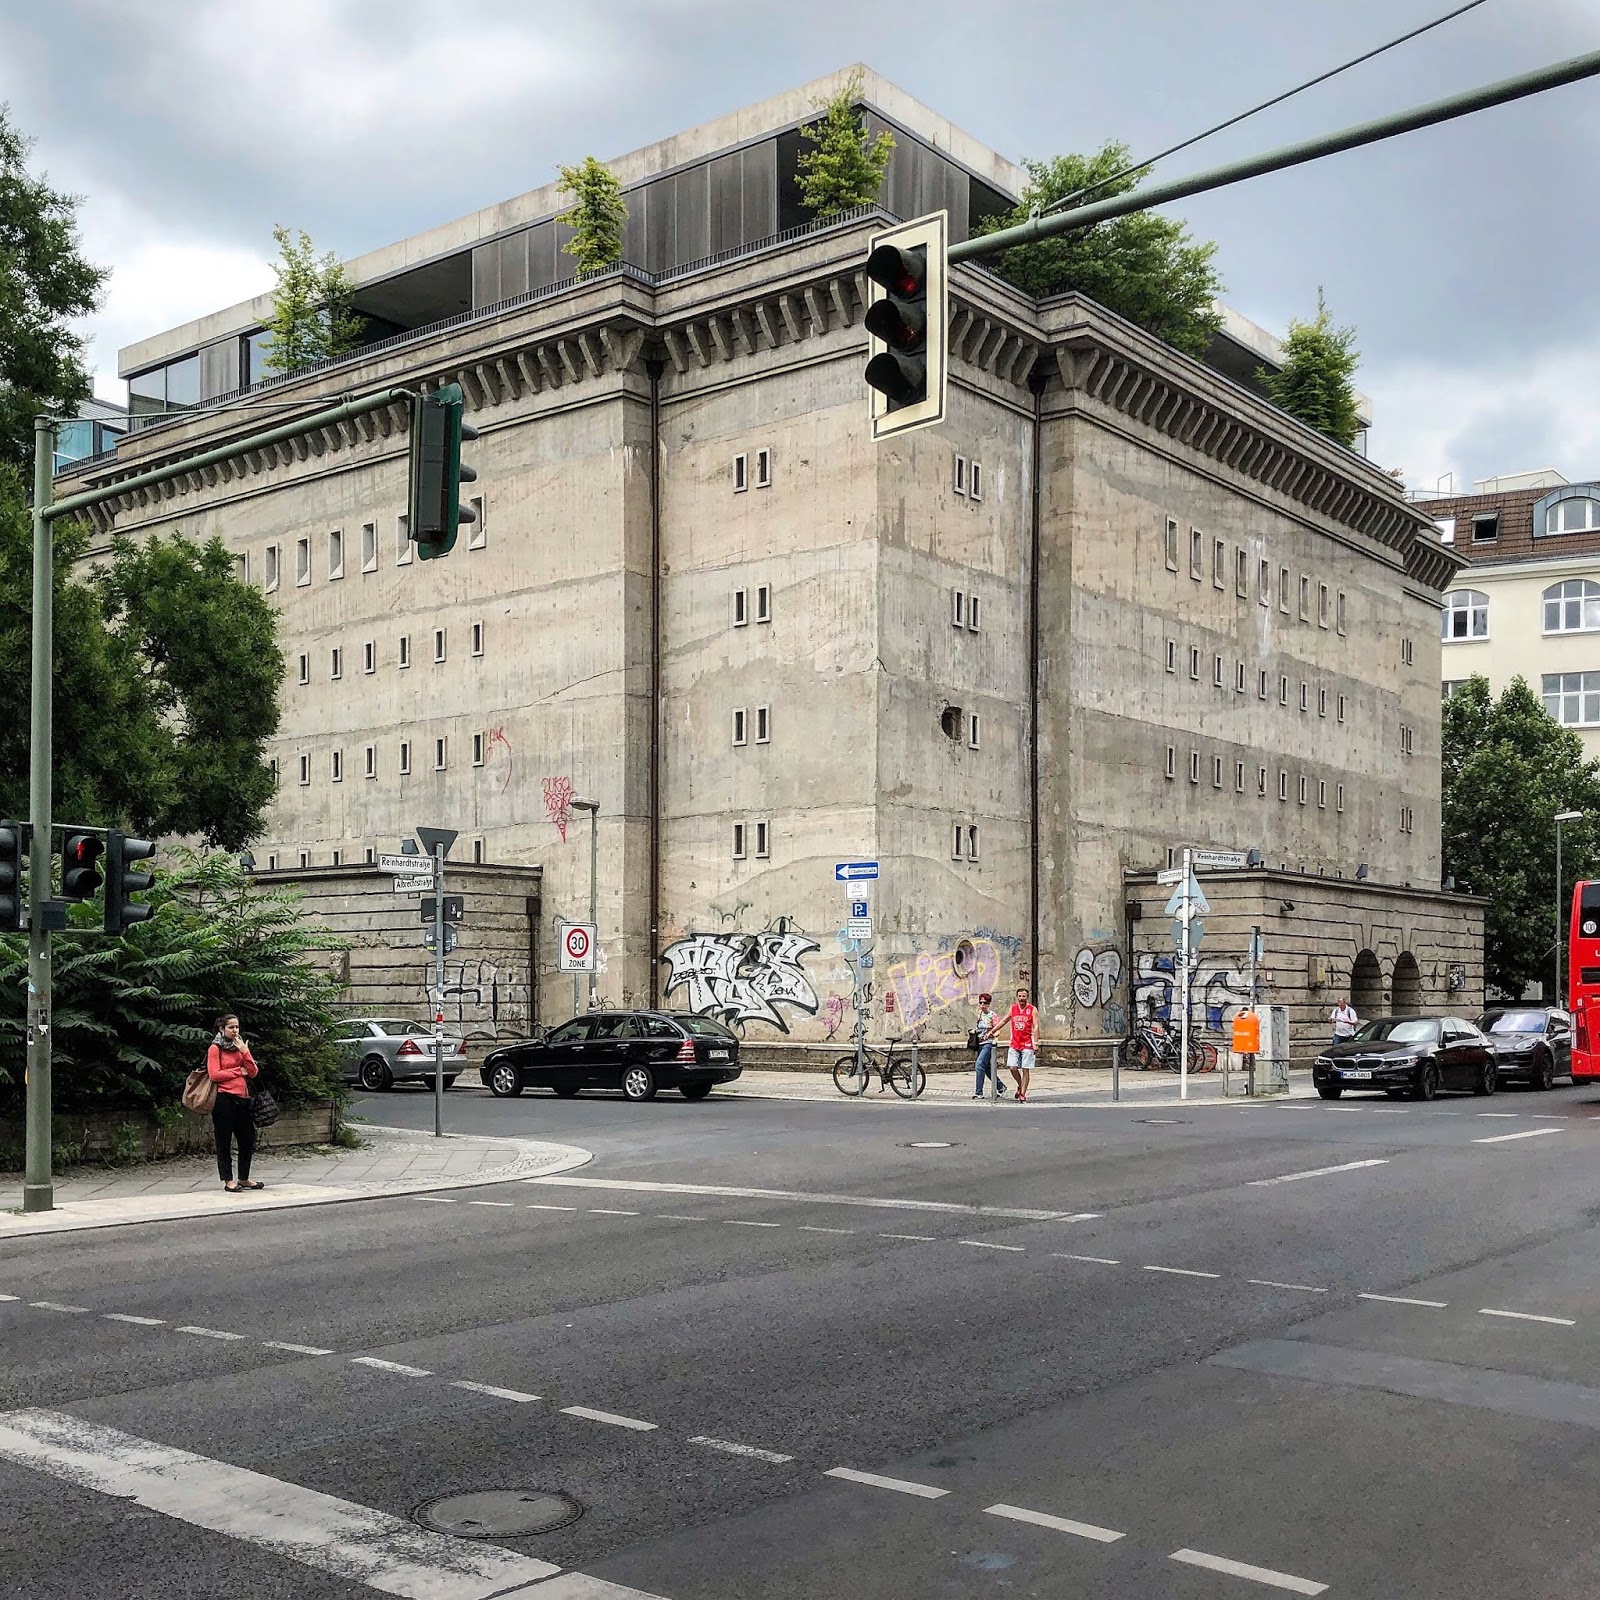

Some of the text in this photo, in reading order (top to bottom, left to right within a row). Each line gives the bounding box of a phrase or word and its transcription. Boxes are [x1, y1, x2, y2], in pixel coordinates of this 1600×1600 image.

[381, 856, 431, 870] Reinhardtstraße
[396, 878, 432, 888] Albrechtstraße
[854, 903, 864, 916] P
[570, 936, 585, 950] 30
[568, 959, 586, 968] ZONE
